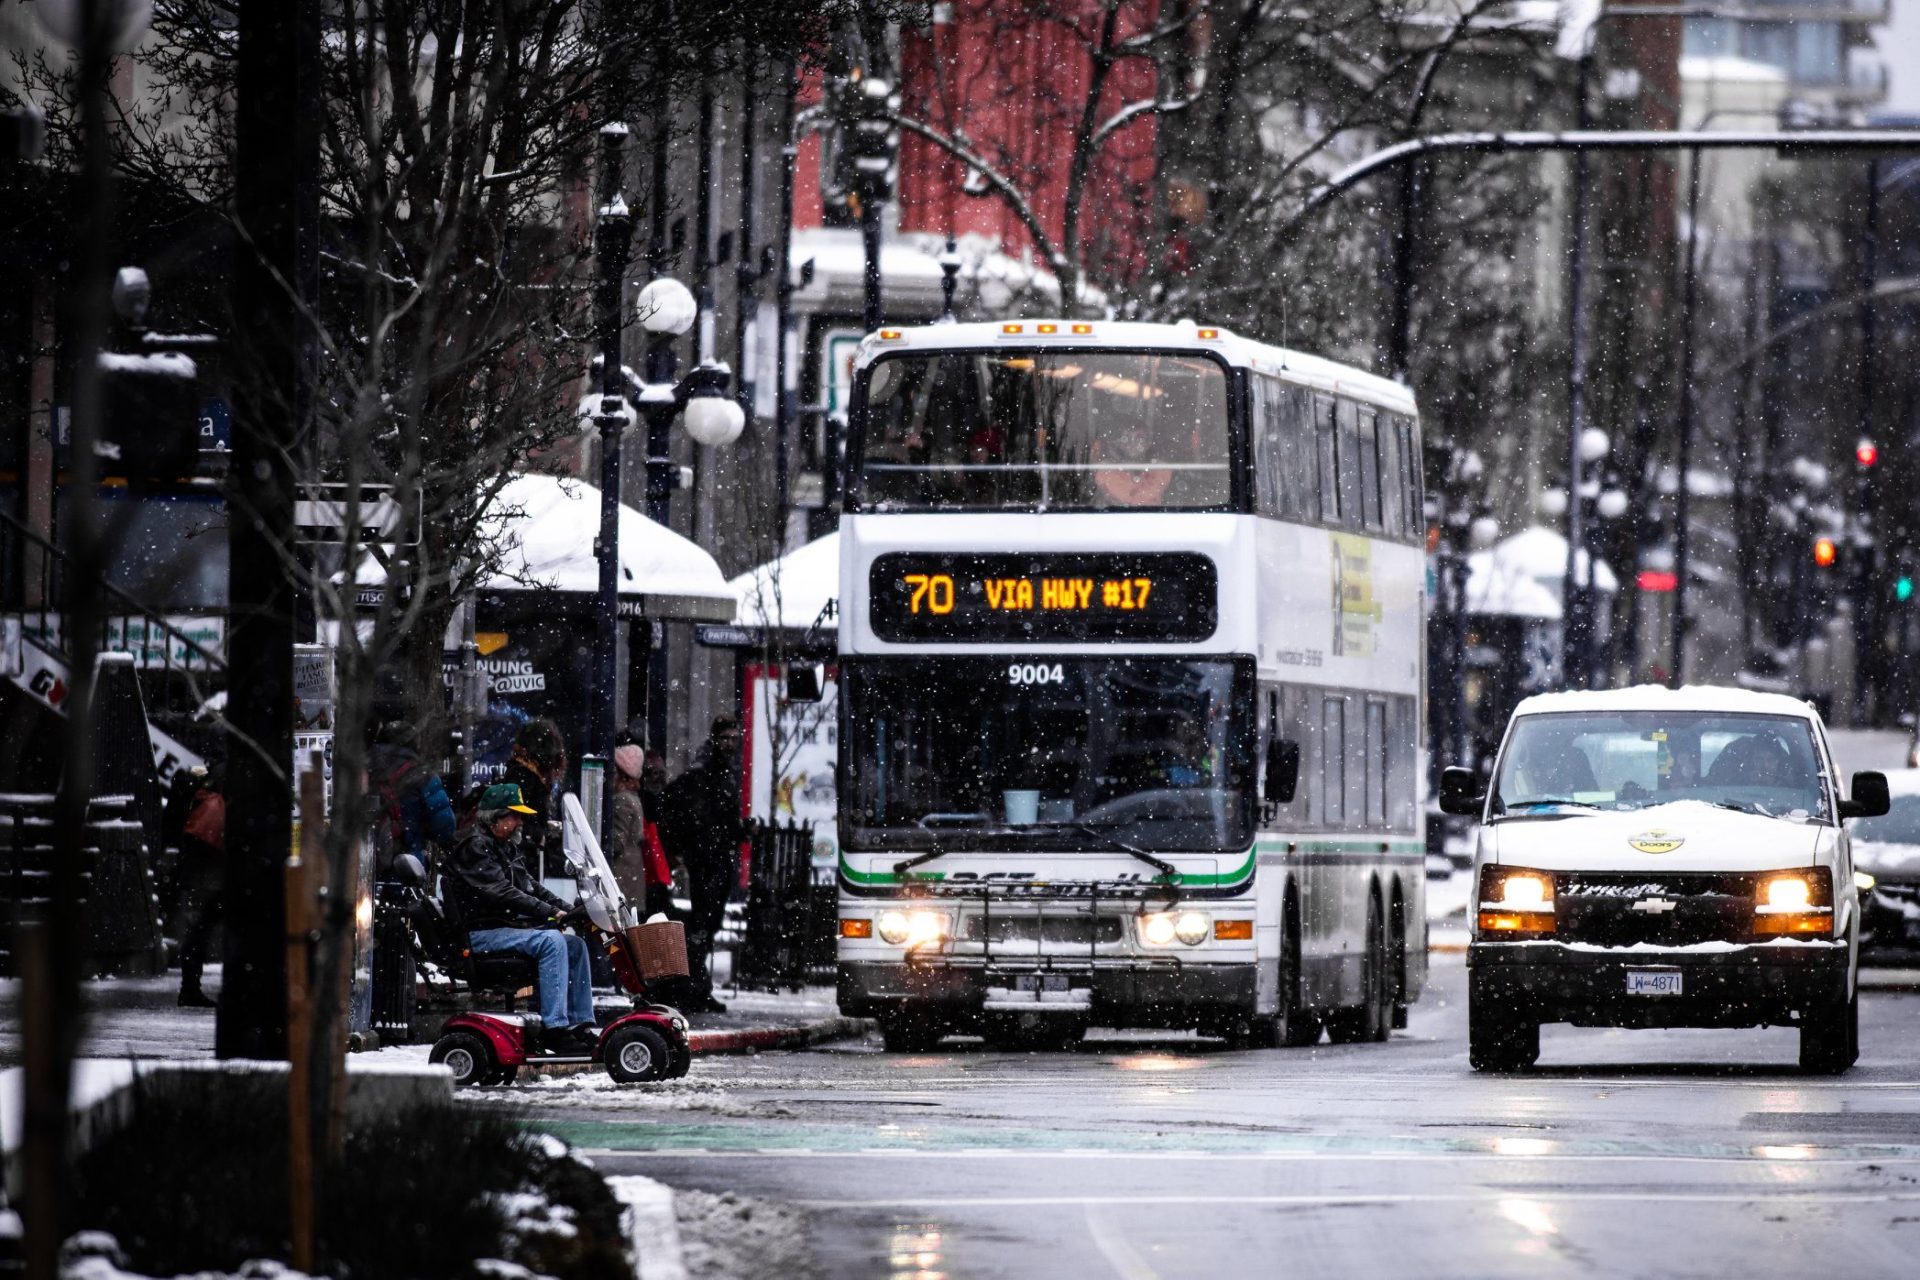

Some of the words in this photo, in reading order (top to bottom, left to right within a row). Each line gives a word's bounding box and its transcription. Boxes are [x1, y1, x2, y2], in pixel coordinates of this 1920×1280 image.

[904, 575, 954, 614] 70
[985, 579, 1033, 609] VIA
[1042, 579, 1093, 609] HWY
[1103, 579, 1151, 609] #17
[1008, 664, 1064, 685] 9004
[1651, 975, 1680, 991] 4871
